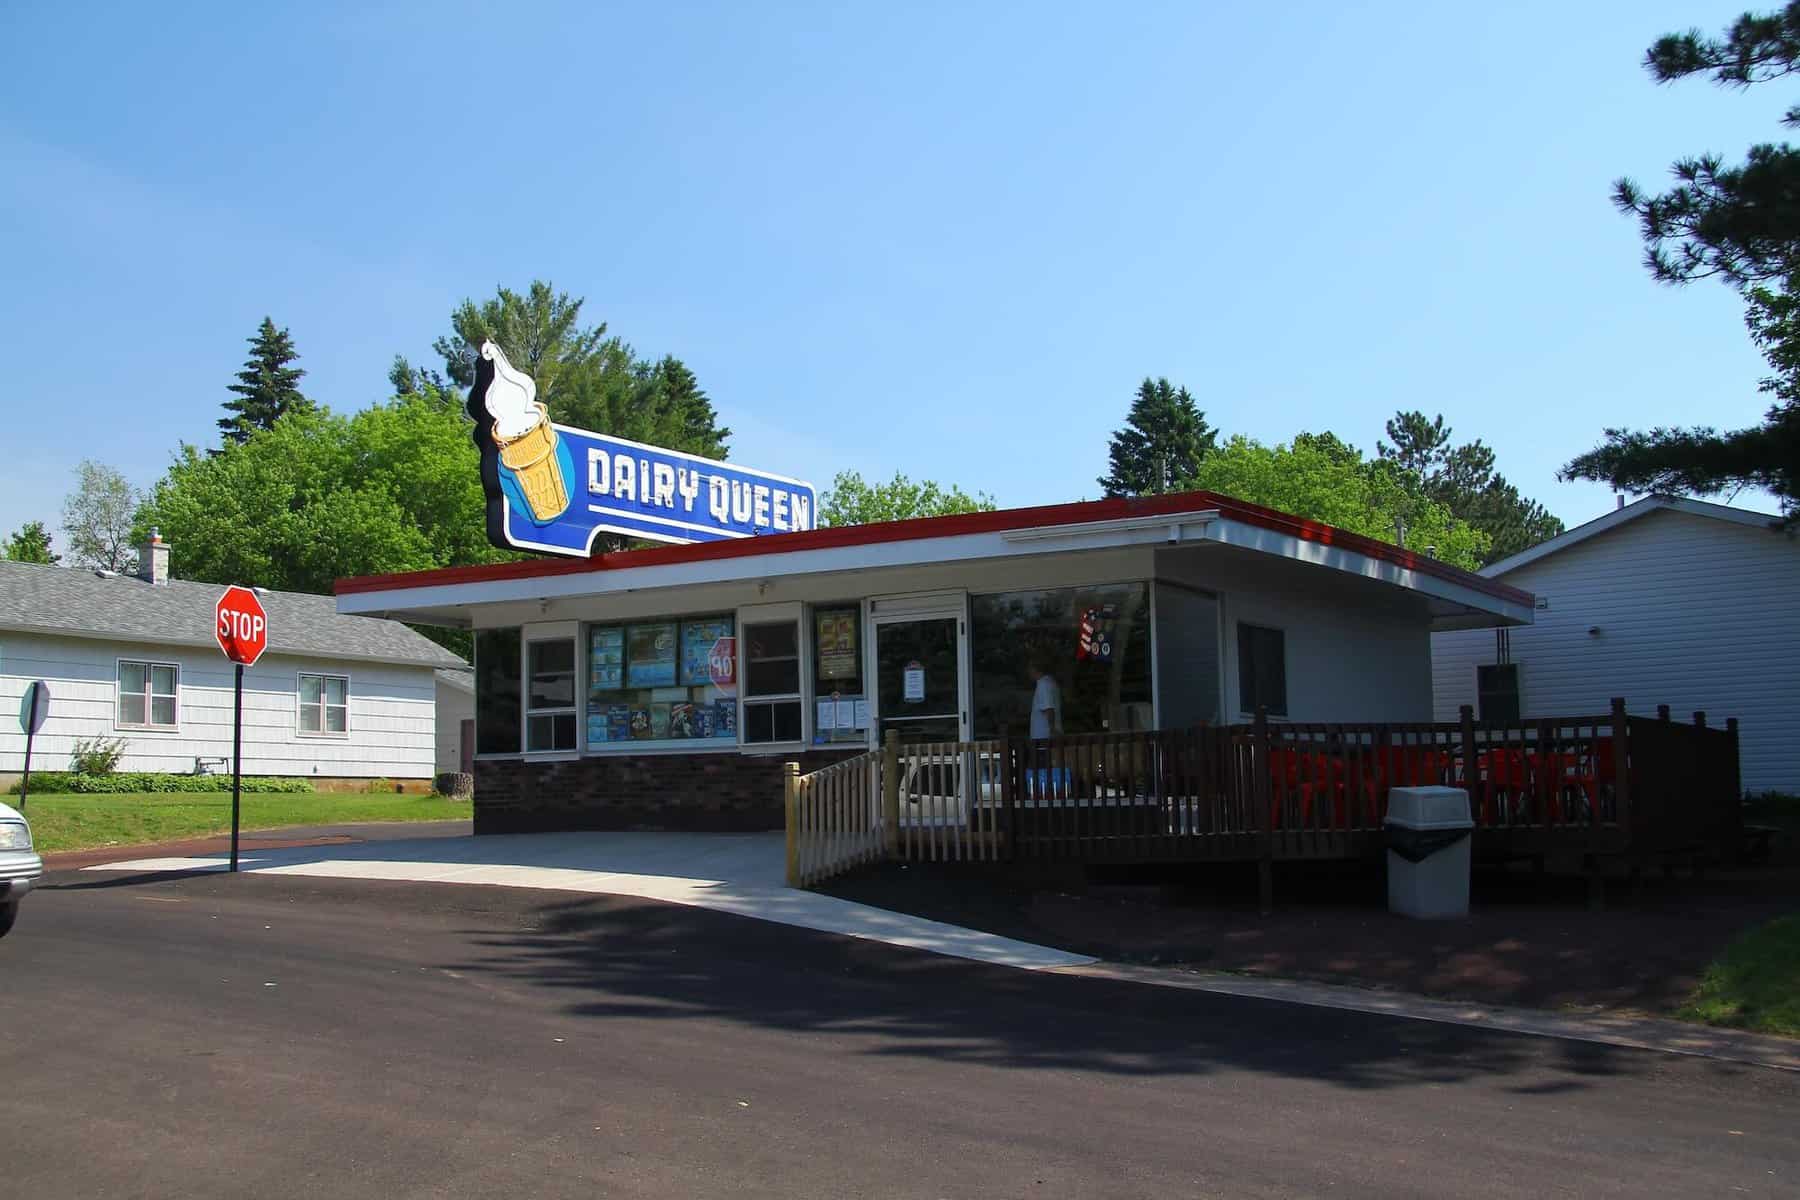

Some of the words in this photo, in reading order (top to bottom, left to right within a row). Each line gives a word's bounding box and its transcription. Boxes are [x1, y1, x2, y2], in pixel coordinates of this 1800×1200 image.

[588, 448, 698, 511] DAIRY
[709, 475, 809, 532] QUEEN
[220, 608, 264, 642] STOP
